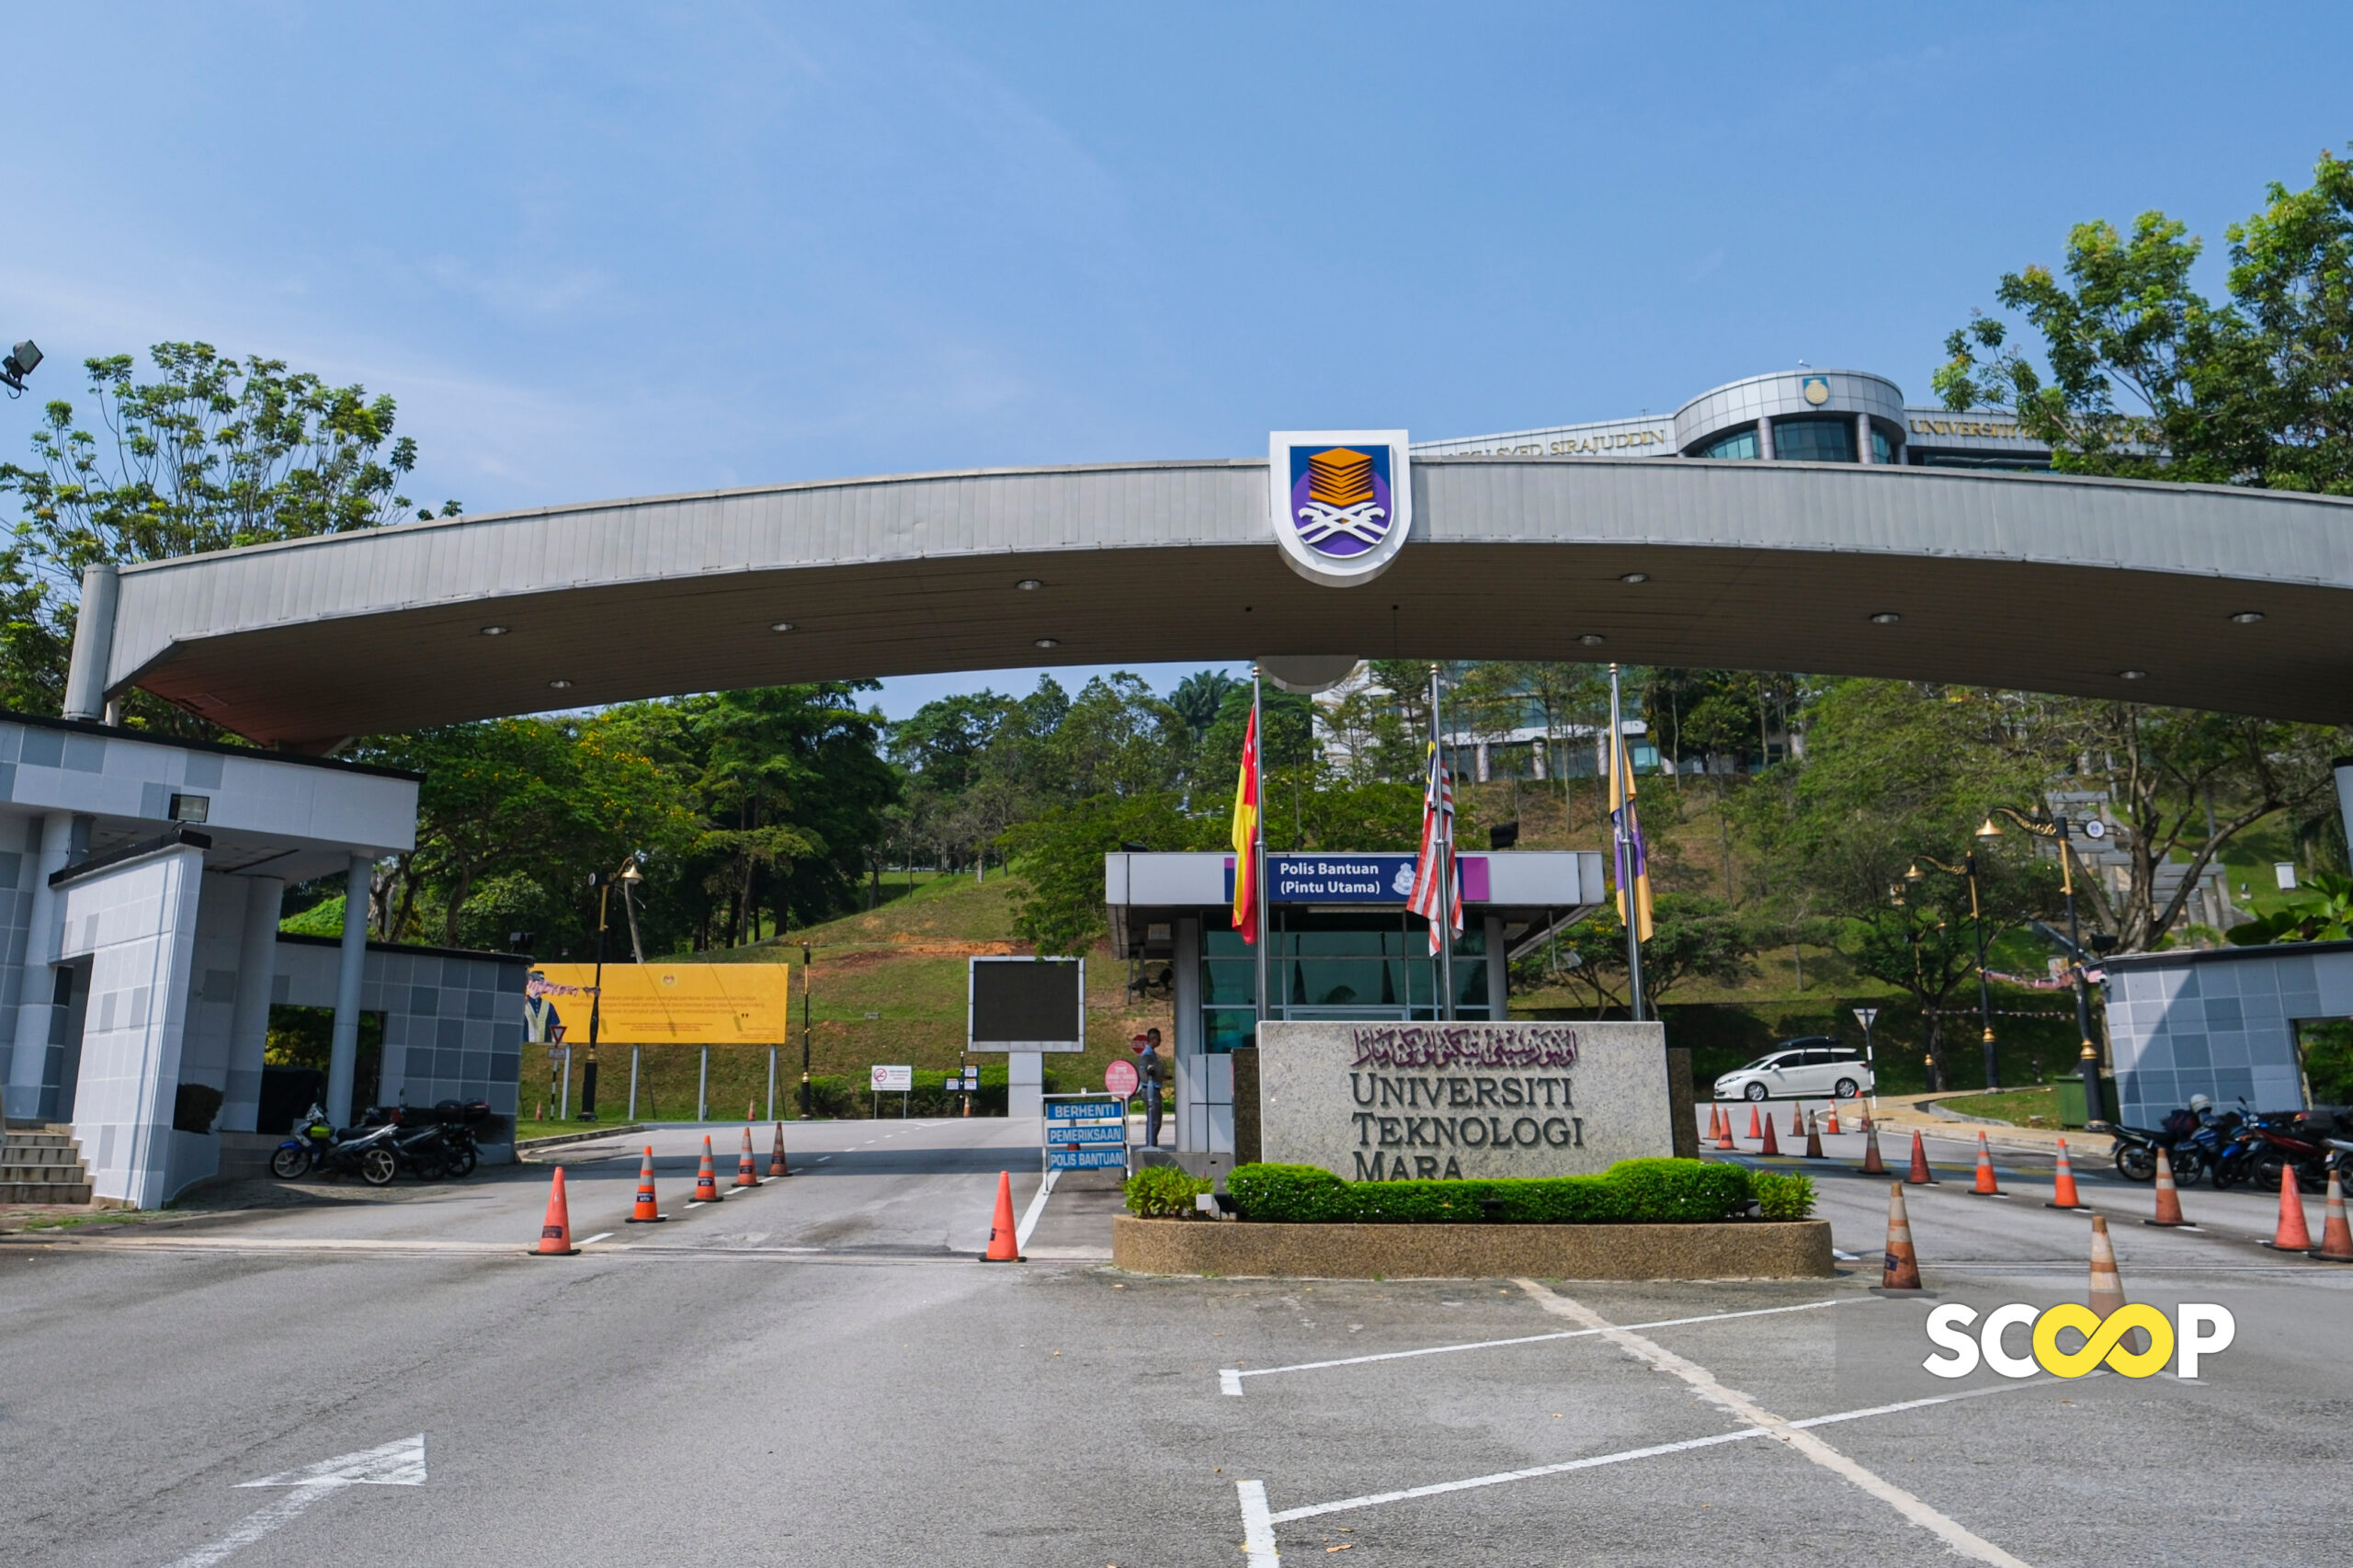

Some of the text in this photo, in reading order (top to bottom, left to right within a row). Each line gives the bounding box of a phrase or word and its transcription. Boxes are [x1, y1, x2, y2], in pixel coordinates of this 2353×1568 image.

[1550, 429, 1665, 456] SIRAJUDDIN
[1280, 862, 1379, 875] Polis Bantuan
[1280, 881, 1381, 895] (Pintu Utama)
[1350, 1073, 1573, 1106] UNIVERSITI
[1054, 1104, 1115, 1118] BERHENTI
[1050, 1127, 1121, 1142] PEMERIKSAAN
[1351, 1112, 1584, 1146] TEKNOLOGI
[1051, 1152, 1123, 1166] POLIS BANTUAN
[1353, 1151, 1463, 1183] MARA
